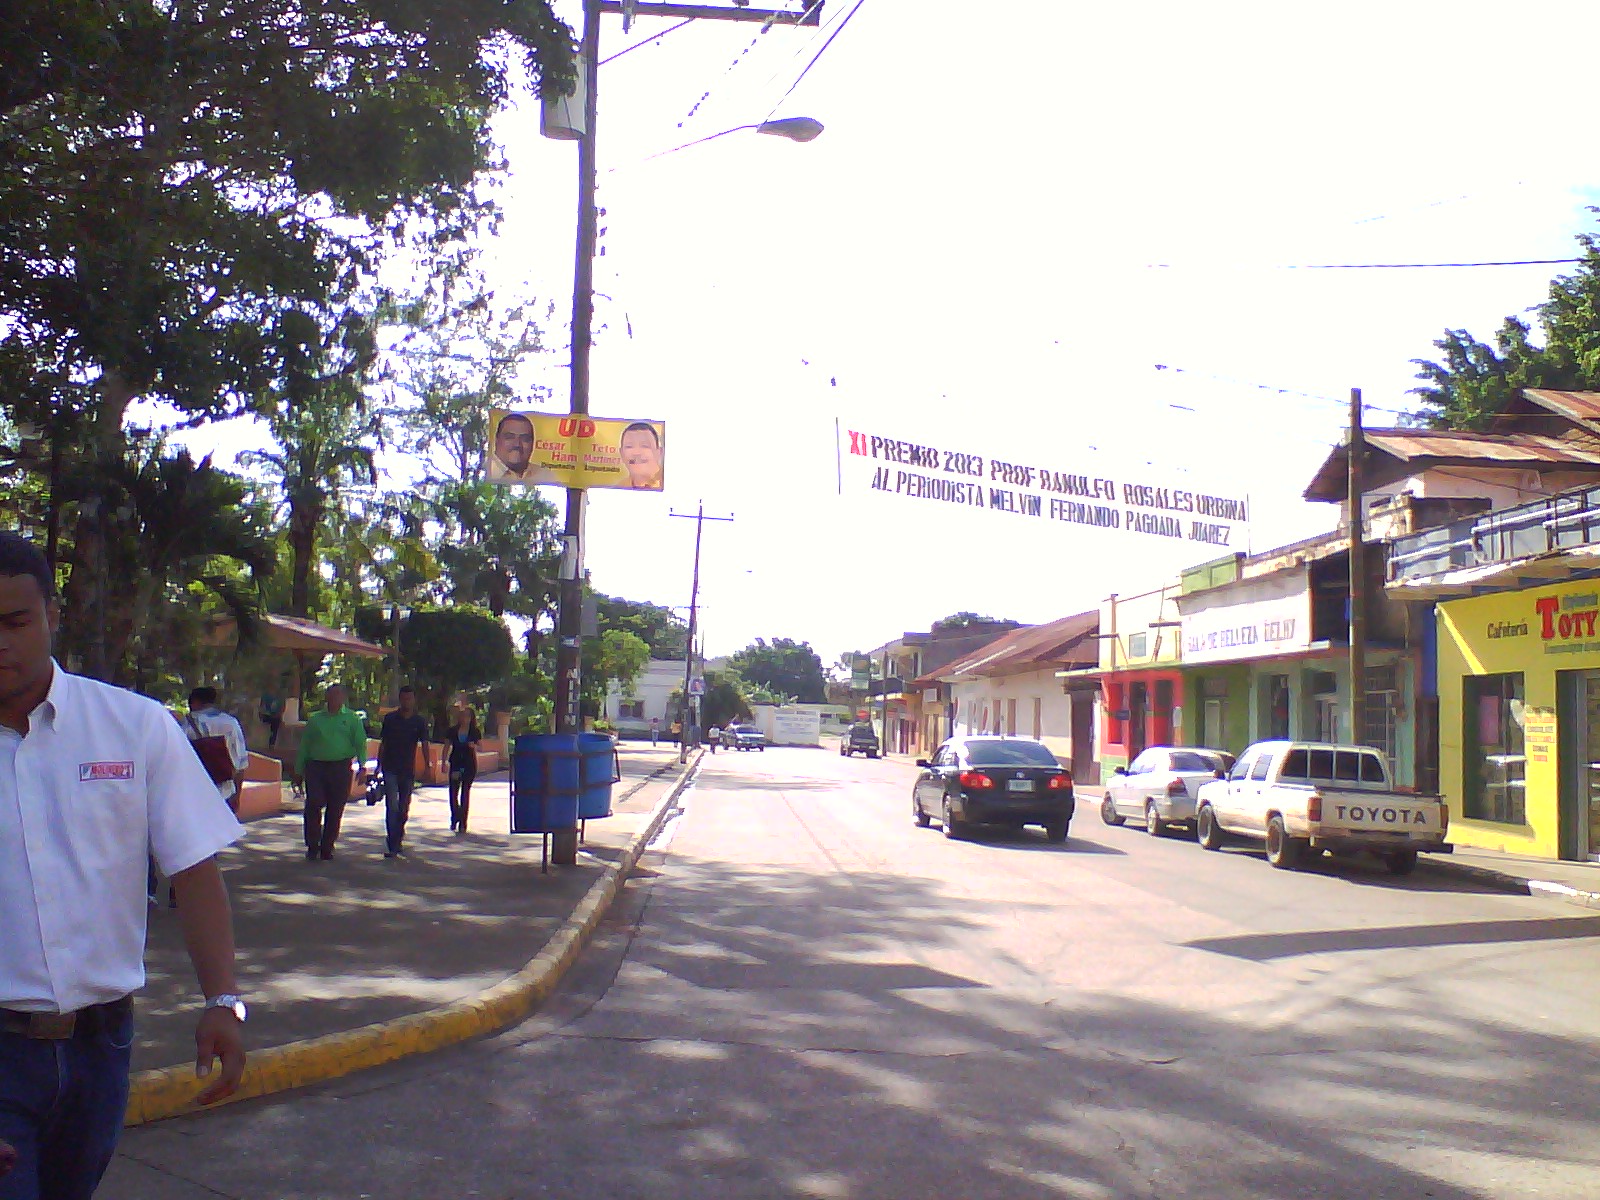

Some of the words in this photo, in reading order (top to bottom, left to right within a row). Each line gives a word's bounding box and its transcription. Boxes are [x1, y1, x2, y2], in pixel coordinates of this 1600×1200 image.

[559, 418, 596, 438] UD
[551, 451, 578, 462] Ham
[591, 444, 617, 454] Teto
[848, 430, 867, 456] XI
[943, 451, 983, 477] 2013
[990, 460, 1036, 487] PROF
[1123, 484, 1193, 512] ROSALES
[871, 466, 892, 492] AL
[1050, 498, 1120, 529] FERNANDO
[1126, 510, 1182, 538] PAGOADA
[1188, 521, 1230, 546] JUAREZ
[1220, 625, 1259, 648] BELLEZA
[1335, 805, 1427, 825] TOYOTA
